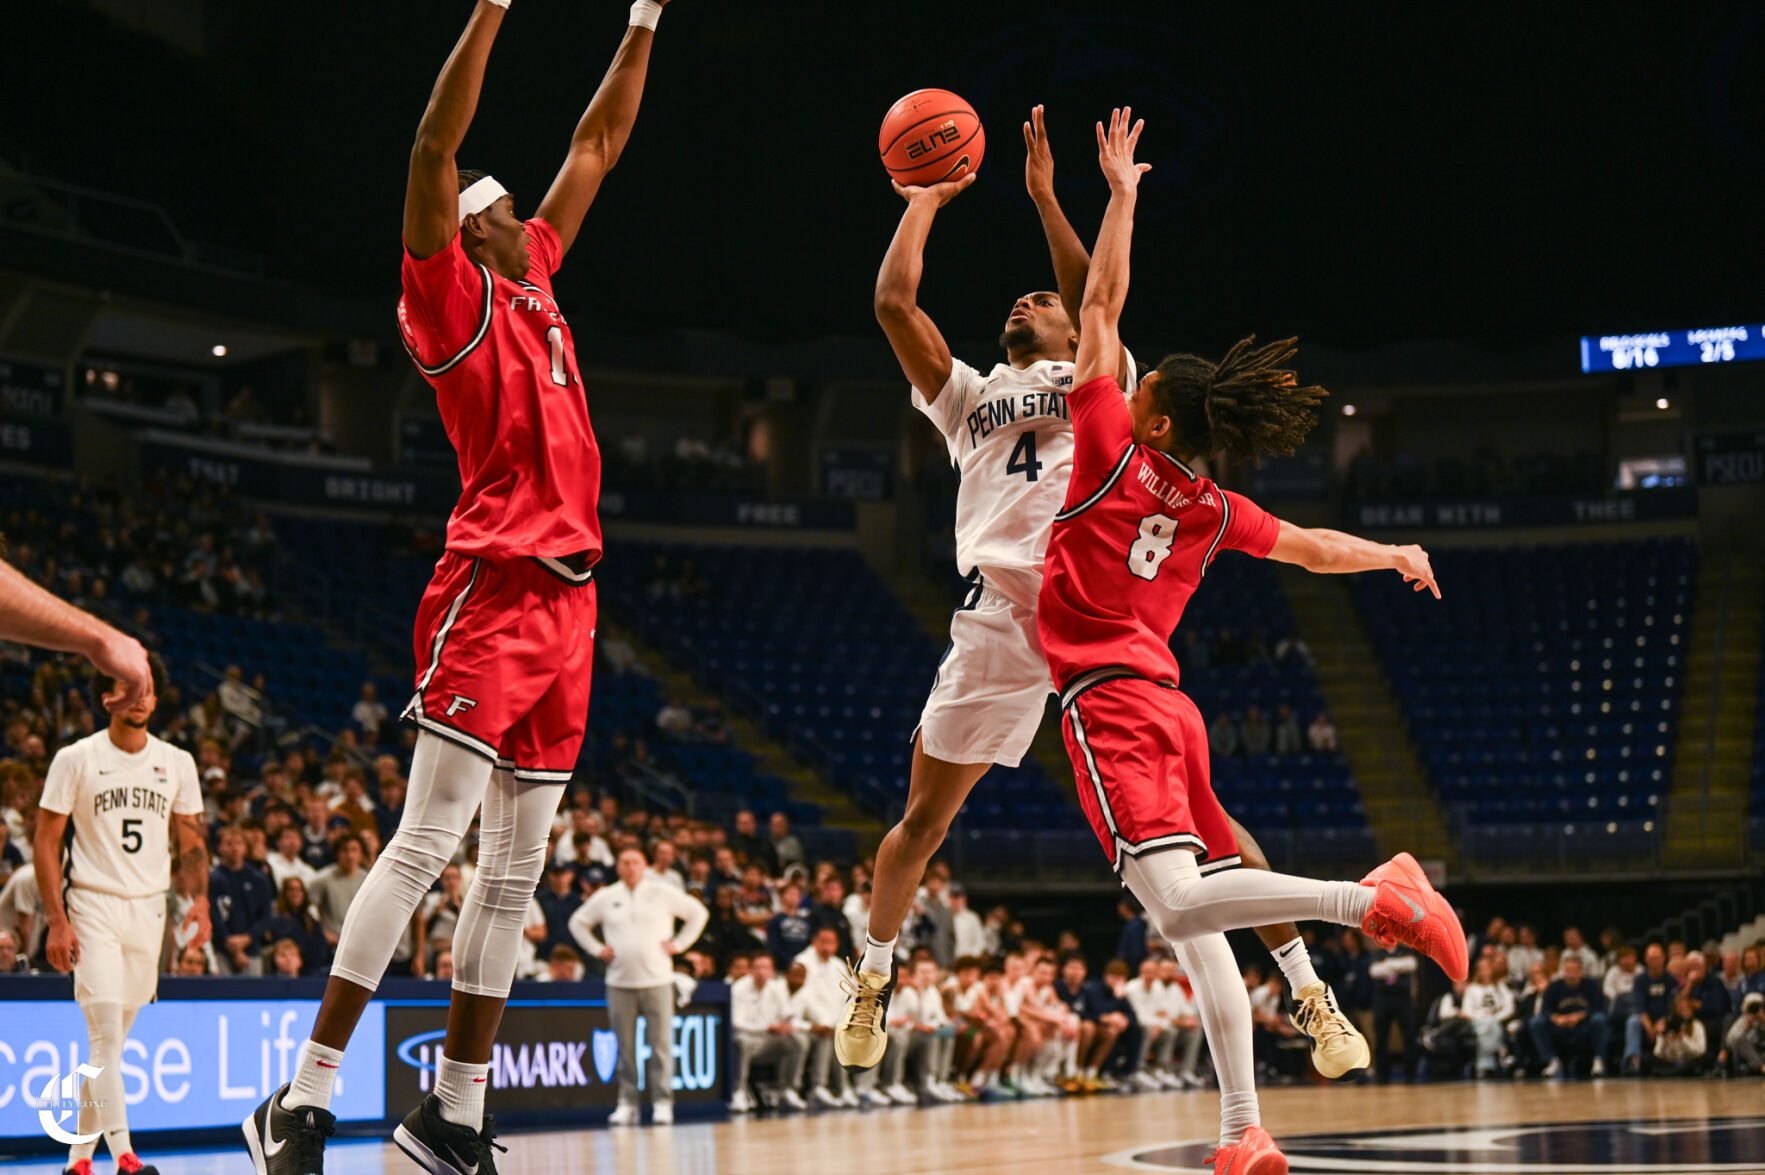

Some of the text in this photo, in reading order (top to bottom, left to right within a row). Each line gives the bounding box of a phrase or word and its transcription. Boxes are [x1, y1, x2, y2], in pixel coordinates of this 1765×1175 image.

[906, 125, 960, 159] ELITE
[966, 392, 1068, 450] PENN STAT
[1006, 430, 1043, 482] 4
[1126, 513, 1178, 582] 8
[445, 694, 478, 717] F
[94, 787, 168, 819] PENN STATE
[121, 818, 143, 854] 5
[420, 1042, 587, 1092] HHMARK
[635, 1014, 717, 1092] PECU
